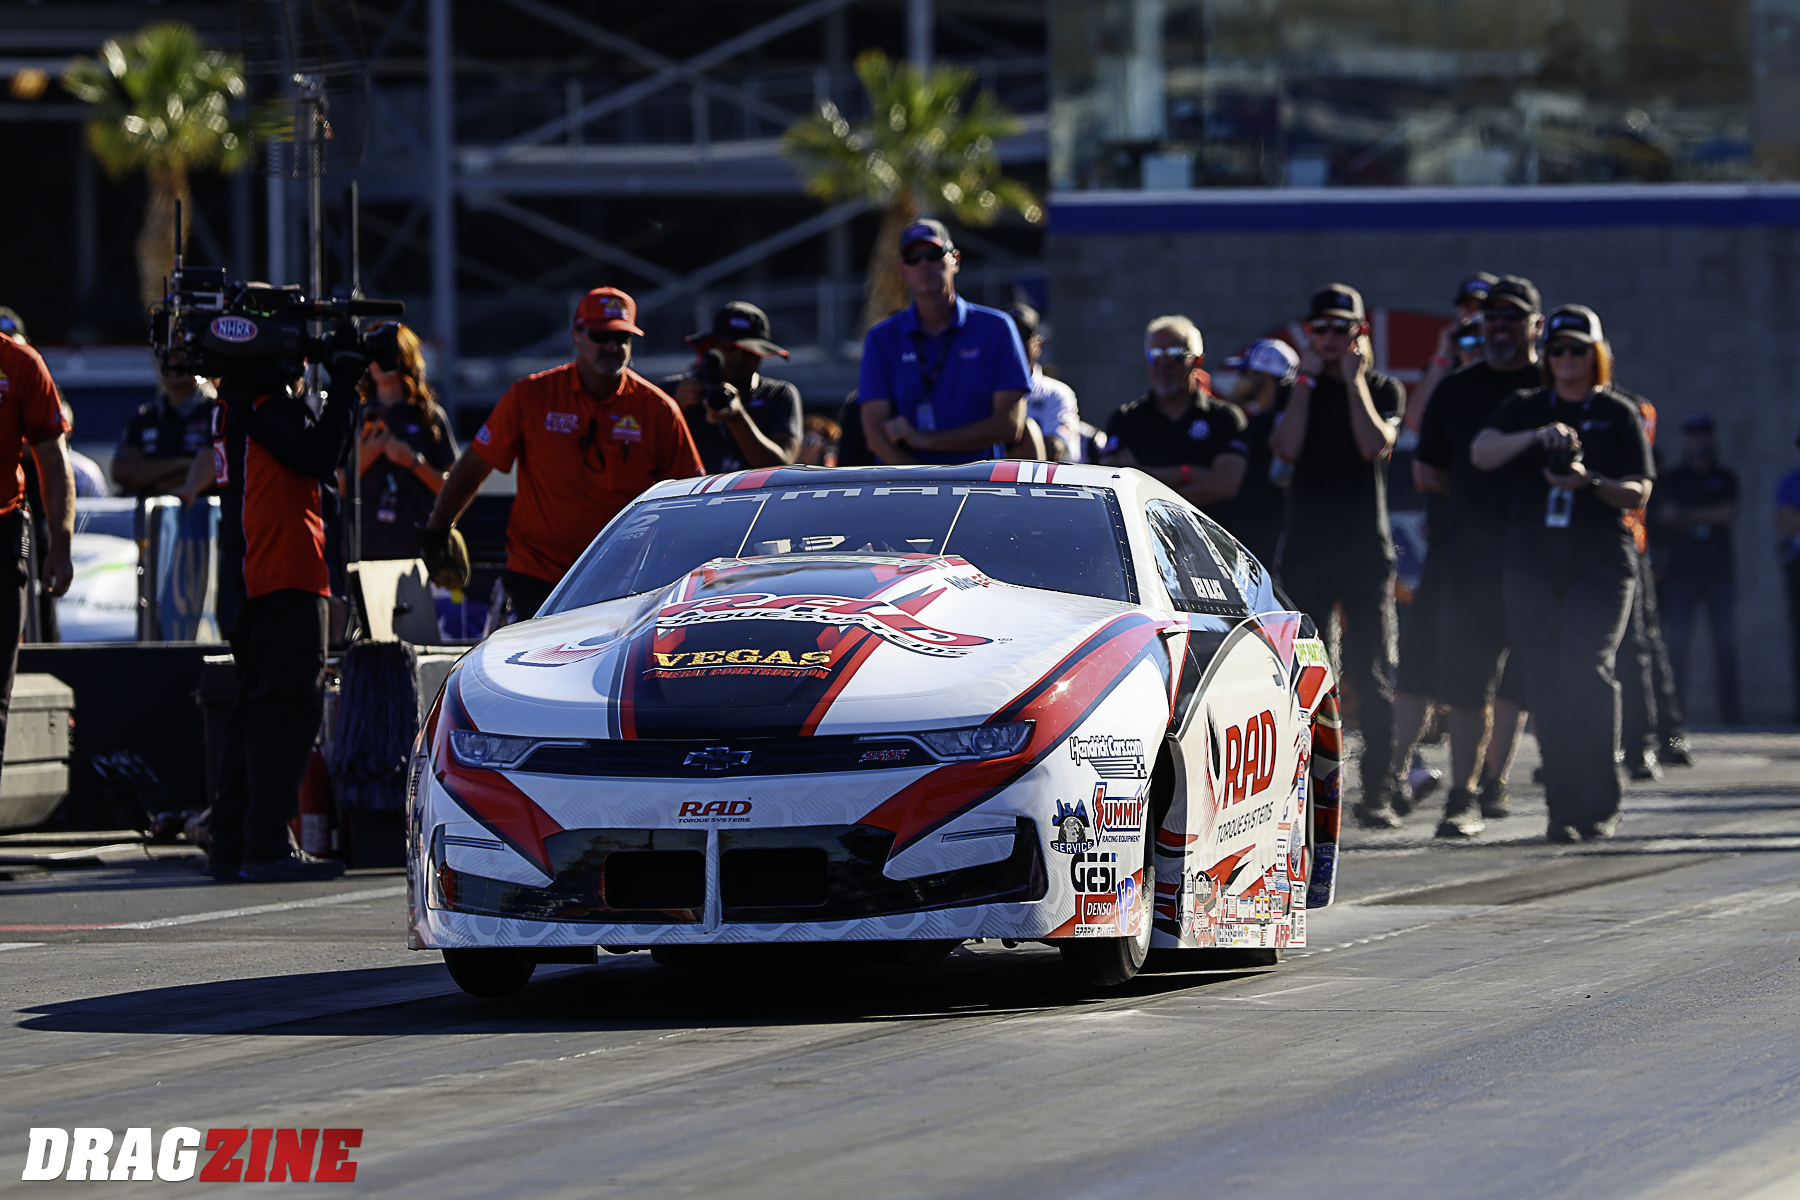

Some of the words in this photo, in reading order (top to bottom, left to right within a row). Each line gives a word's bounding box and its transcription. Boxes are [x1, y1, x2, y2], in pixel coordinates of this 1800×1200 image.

[218, 320, 251, 338] NHRA
[641, 486, 1095, 512] CAMARO
[652, 648, 833, 667] VEGAS
[642, 668, 706, 682] GENERAL
[708, 667, 830, 680] CONSTRUCTION
[1222, 709, 1277, 811] RAD
[678, 800, 752, 816] RAD
[1052, 798, 1091, 828] J&A
[1093, 782, 1143, 842] SUMMIT
[1051, 841, 1093, 854] SERVICE
[1102, 835, 1117, 843] RACING
[1118, 835, 1141, 843] EQUIPMENT
[1086, 902, 1113, 917] DENSO
[1075, 926, 1096, 936] SPARK
[1096, 926, 1115, 936] PLUGS
